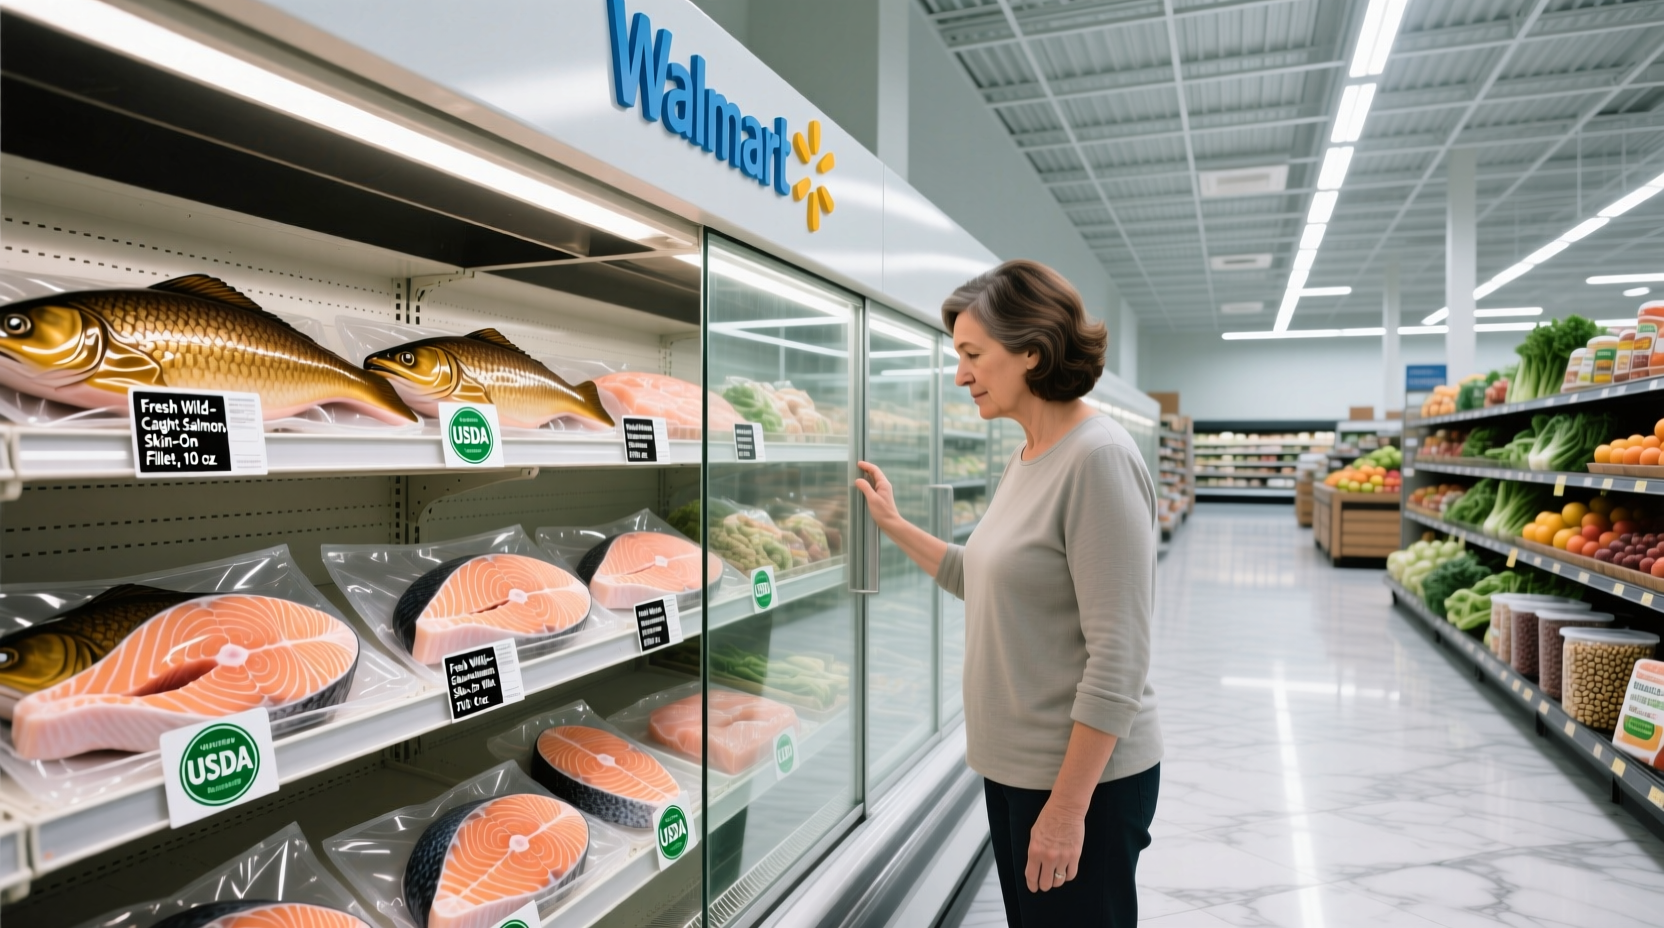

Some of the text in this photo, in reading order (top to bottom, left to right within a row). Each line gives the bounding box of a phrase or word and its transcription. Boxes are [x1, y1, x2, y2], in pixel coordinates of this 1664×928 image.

[607, 0, 791, 196] Walmart
[140, 398, 178, 414] Fresh
[180, 399, 217, 415] Wild-
[144, 433, 199, 448] Skin-On
[452, 425, 490, 445] USDA
[146, 450, 218, 468] Fillet, 10 oz
[187, 745, 254, 786] USDA
